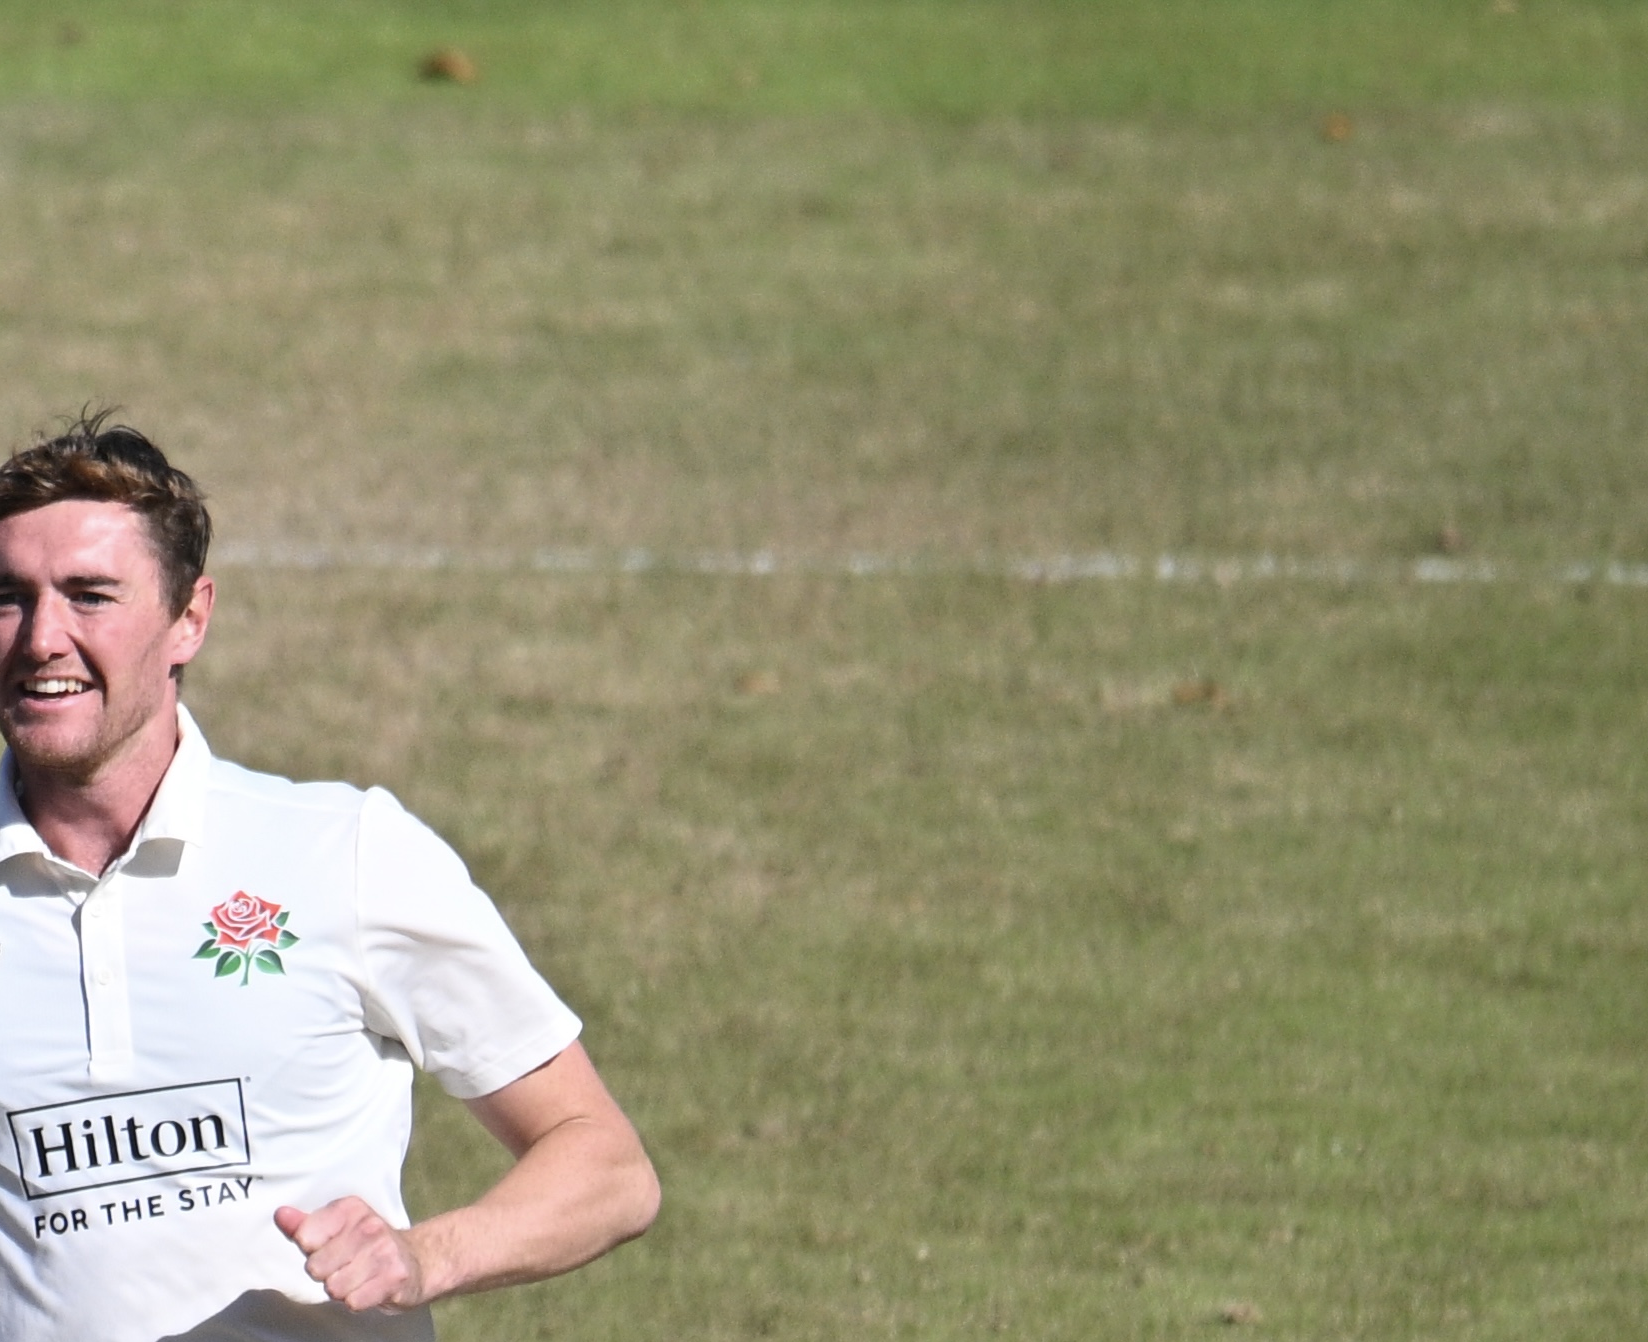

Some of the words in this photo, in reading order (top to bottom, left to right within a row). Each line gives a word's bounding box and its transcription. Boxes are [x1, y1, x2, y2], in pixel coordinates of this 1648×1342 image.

[30, 1114, 229, 1178] Hilton
[34, 1208, 89, 1239] FOR
[100, 1195, 164, 1225] THE
[179, 1176, 253, 1211] STAY
